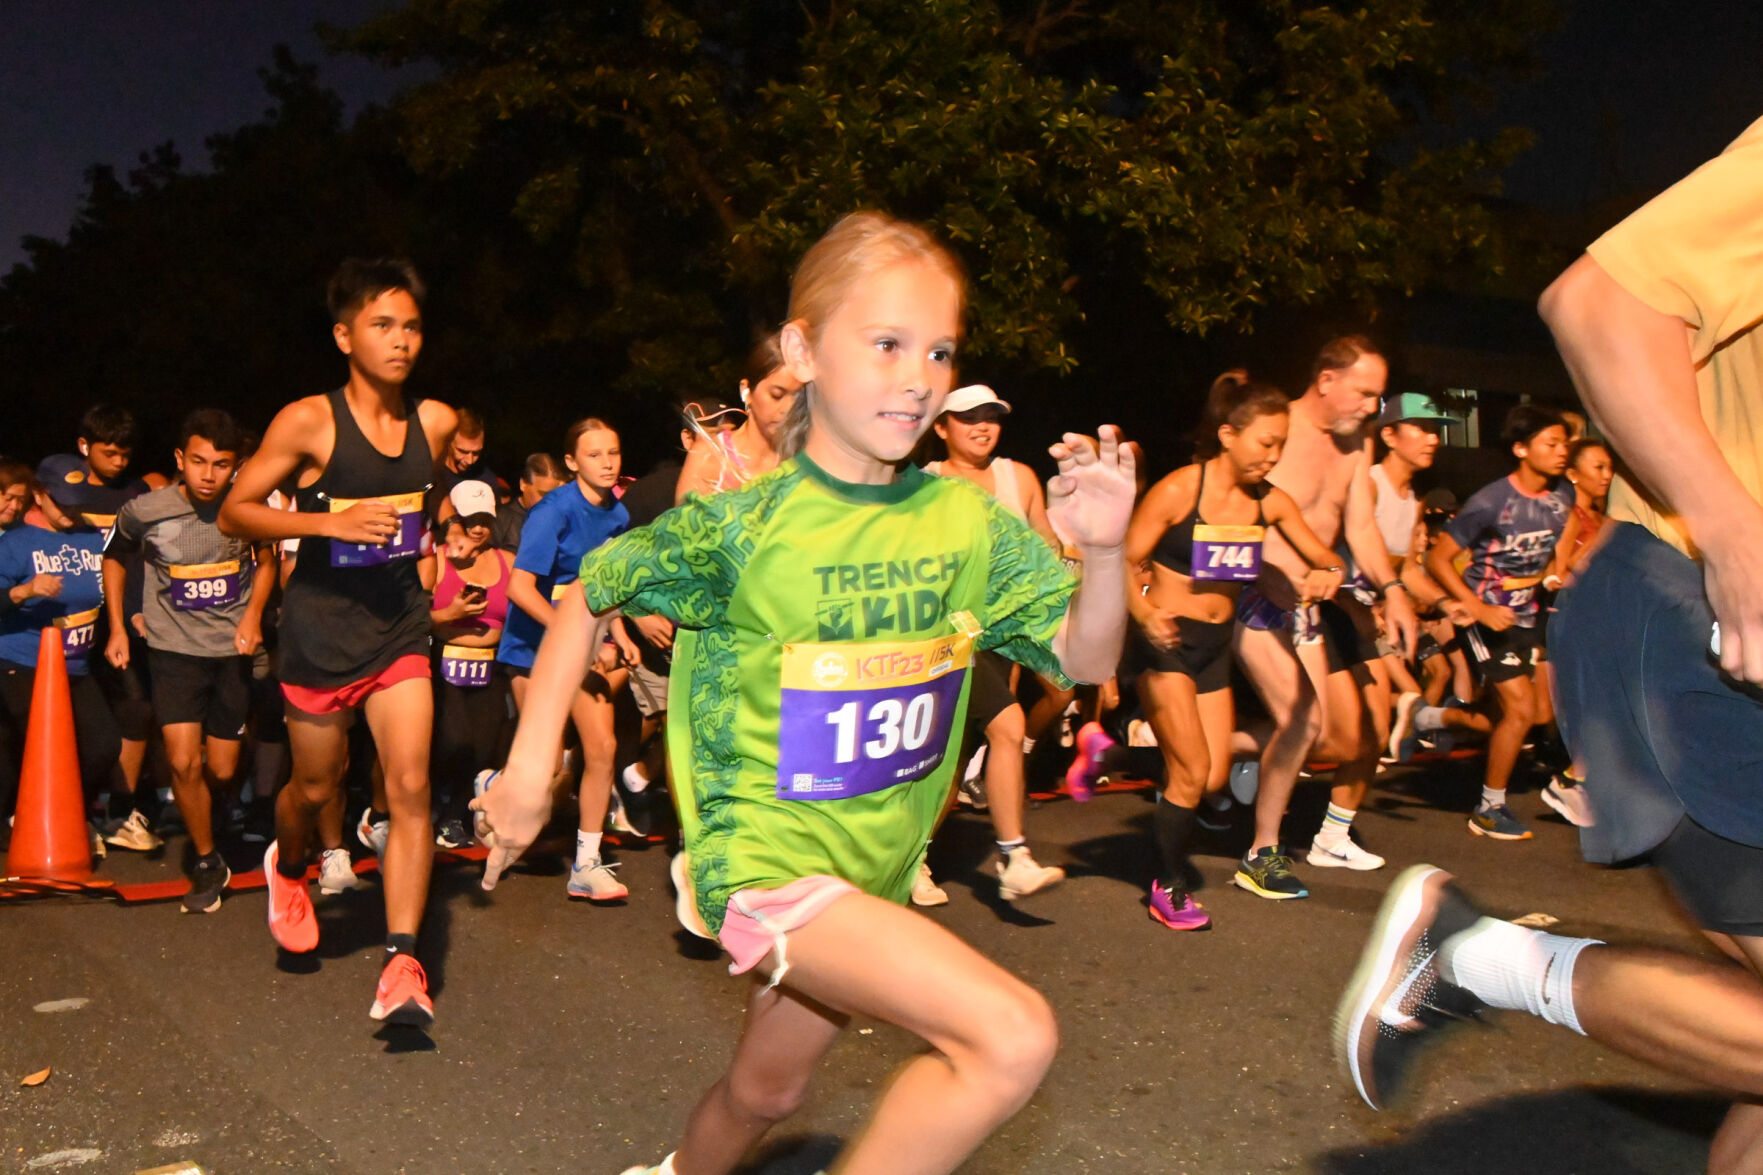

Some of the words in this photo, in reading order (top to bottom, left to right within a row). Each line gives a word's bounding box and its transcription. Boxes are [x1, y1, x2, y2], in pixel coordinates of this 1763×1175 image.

[32, 550, 63, 575] Blue
[1207, 545, 1254, 568] 744
[813, 551, 961, 595] TRENCH
[184, 578, 227, 599] 399
[67, 624, 95, 646] 477
[447, 660, 488, 678] 1111
[856, 651, 925, 680] KTF23
[826, 692, 935, 764] 130
